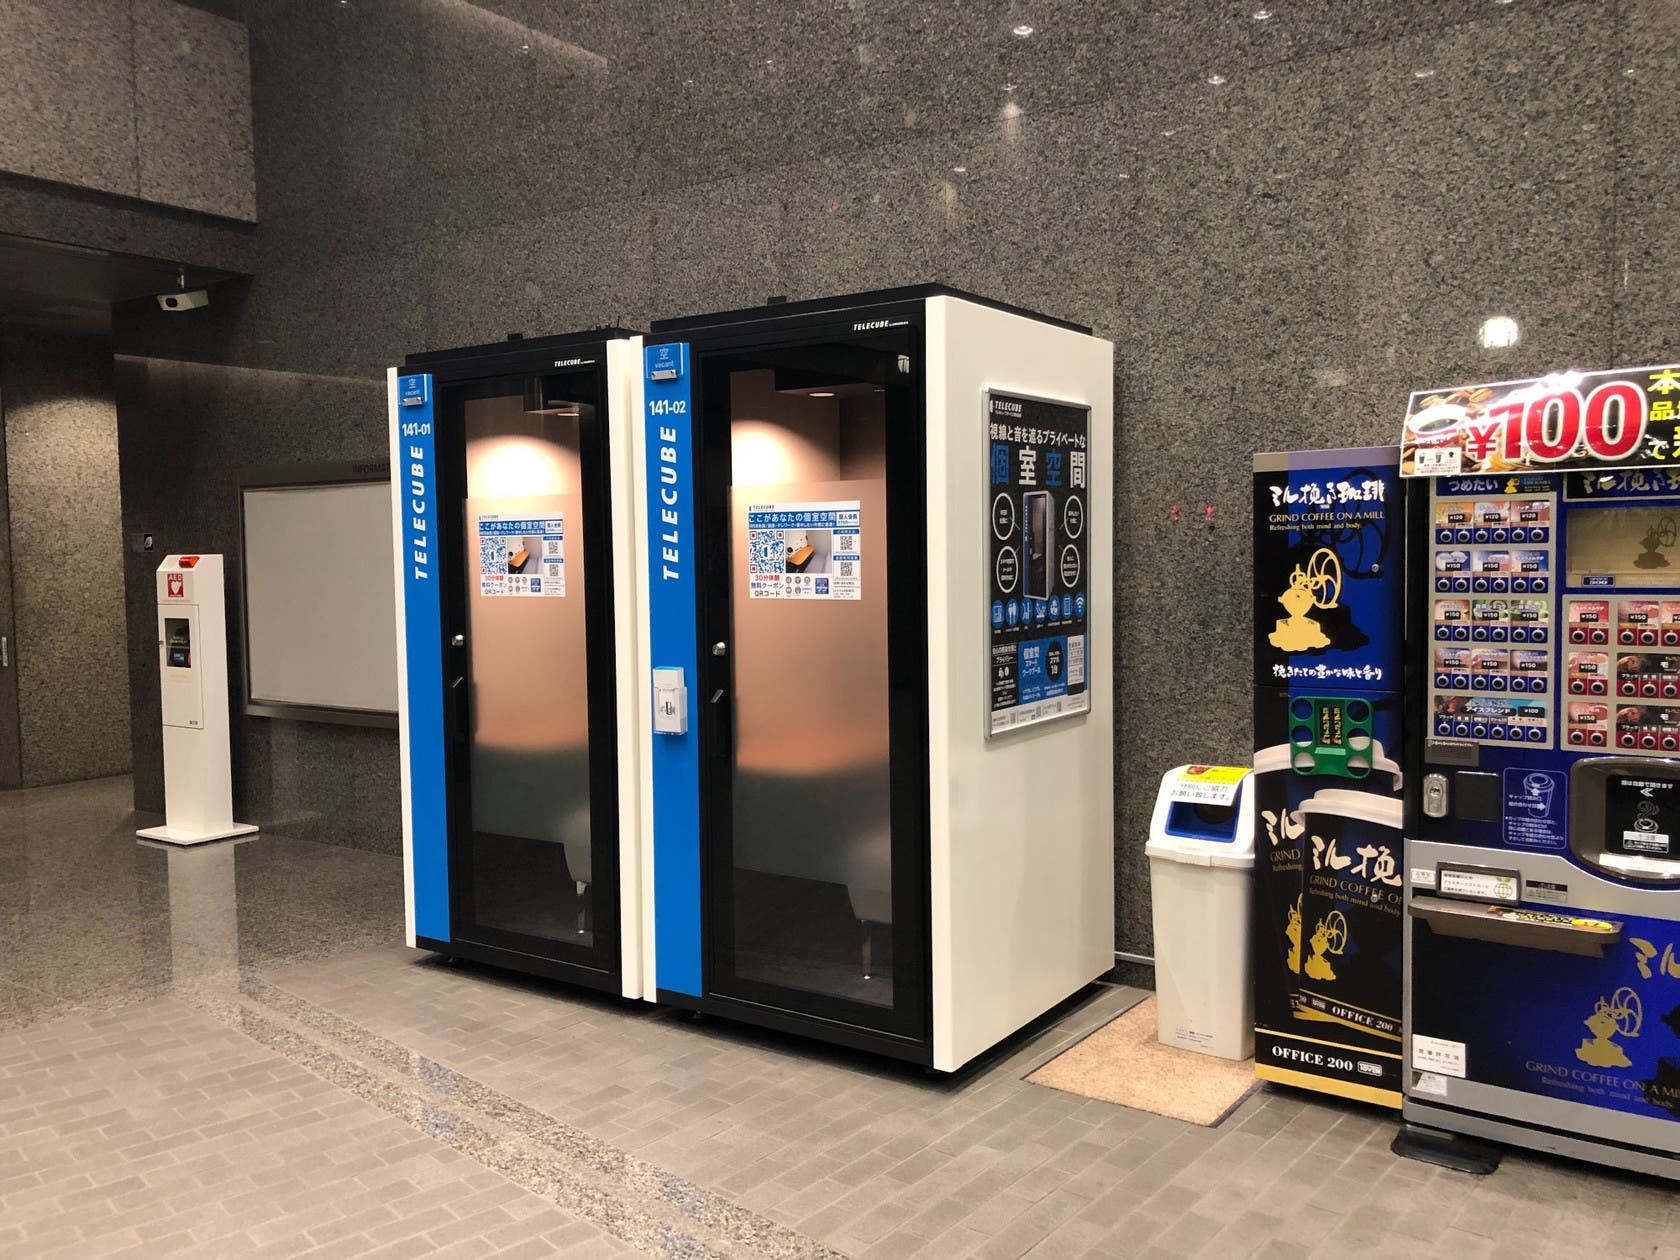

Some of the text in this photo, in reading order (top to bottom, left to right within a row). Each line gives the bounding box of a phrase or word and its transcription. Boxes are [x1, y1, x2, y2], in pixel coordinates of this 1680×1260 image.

[853, 320, 889, 331] TELECUBE
[649, 400, 687, 416] 141-02
[995, 400, 1022, 413] TELECUBE
[1649, 401, 1680, 421] 品
[402, 422, 431, 437] 141-01
[1467, 381, 1648, 462] ¥100
[990, 423, 1087, 448] 視線と音を遮るプライベートな
[991, 443, 1086, 489] 個室空間
[1448, 479, 1499, 492] つめたい
[410, 446, 428, 579] TELECUBE
[660, 426, 680, 580] TELECUBE
[749, 512, 836, 523] ここがあなたの個室空間
[1269, 511, 1385, 522] GRIND COFFEE ON A MILL
[1269, 524, 1301, 532] Refreshing
[1302, 523, 1315, 531] both
[1270, 849, 1301, 863] GRIND
[1309, 874, 1338, 888] GRIND
[1340, 880, 1385, 899] COFFEE
[1331, 1006, 1393, 1032] OFFICE 200
[1272, 1045, 1324, 1065] OFFICE
[1327, 1057, 1353, 1071] 200
[1525, 1060, 1569, 1077] GRIND
[1571, 1069, 1619, 1088] COFFEE
[1623, 1079, 1645, 1092] ON
[1651, 1084, 1660, 1095] A
